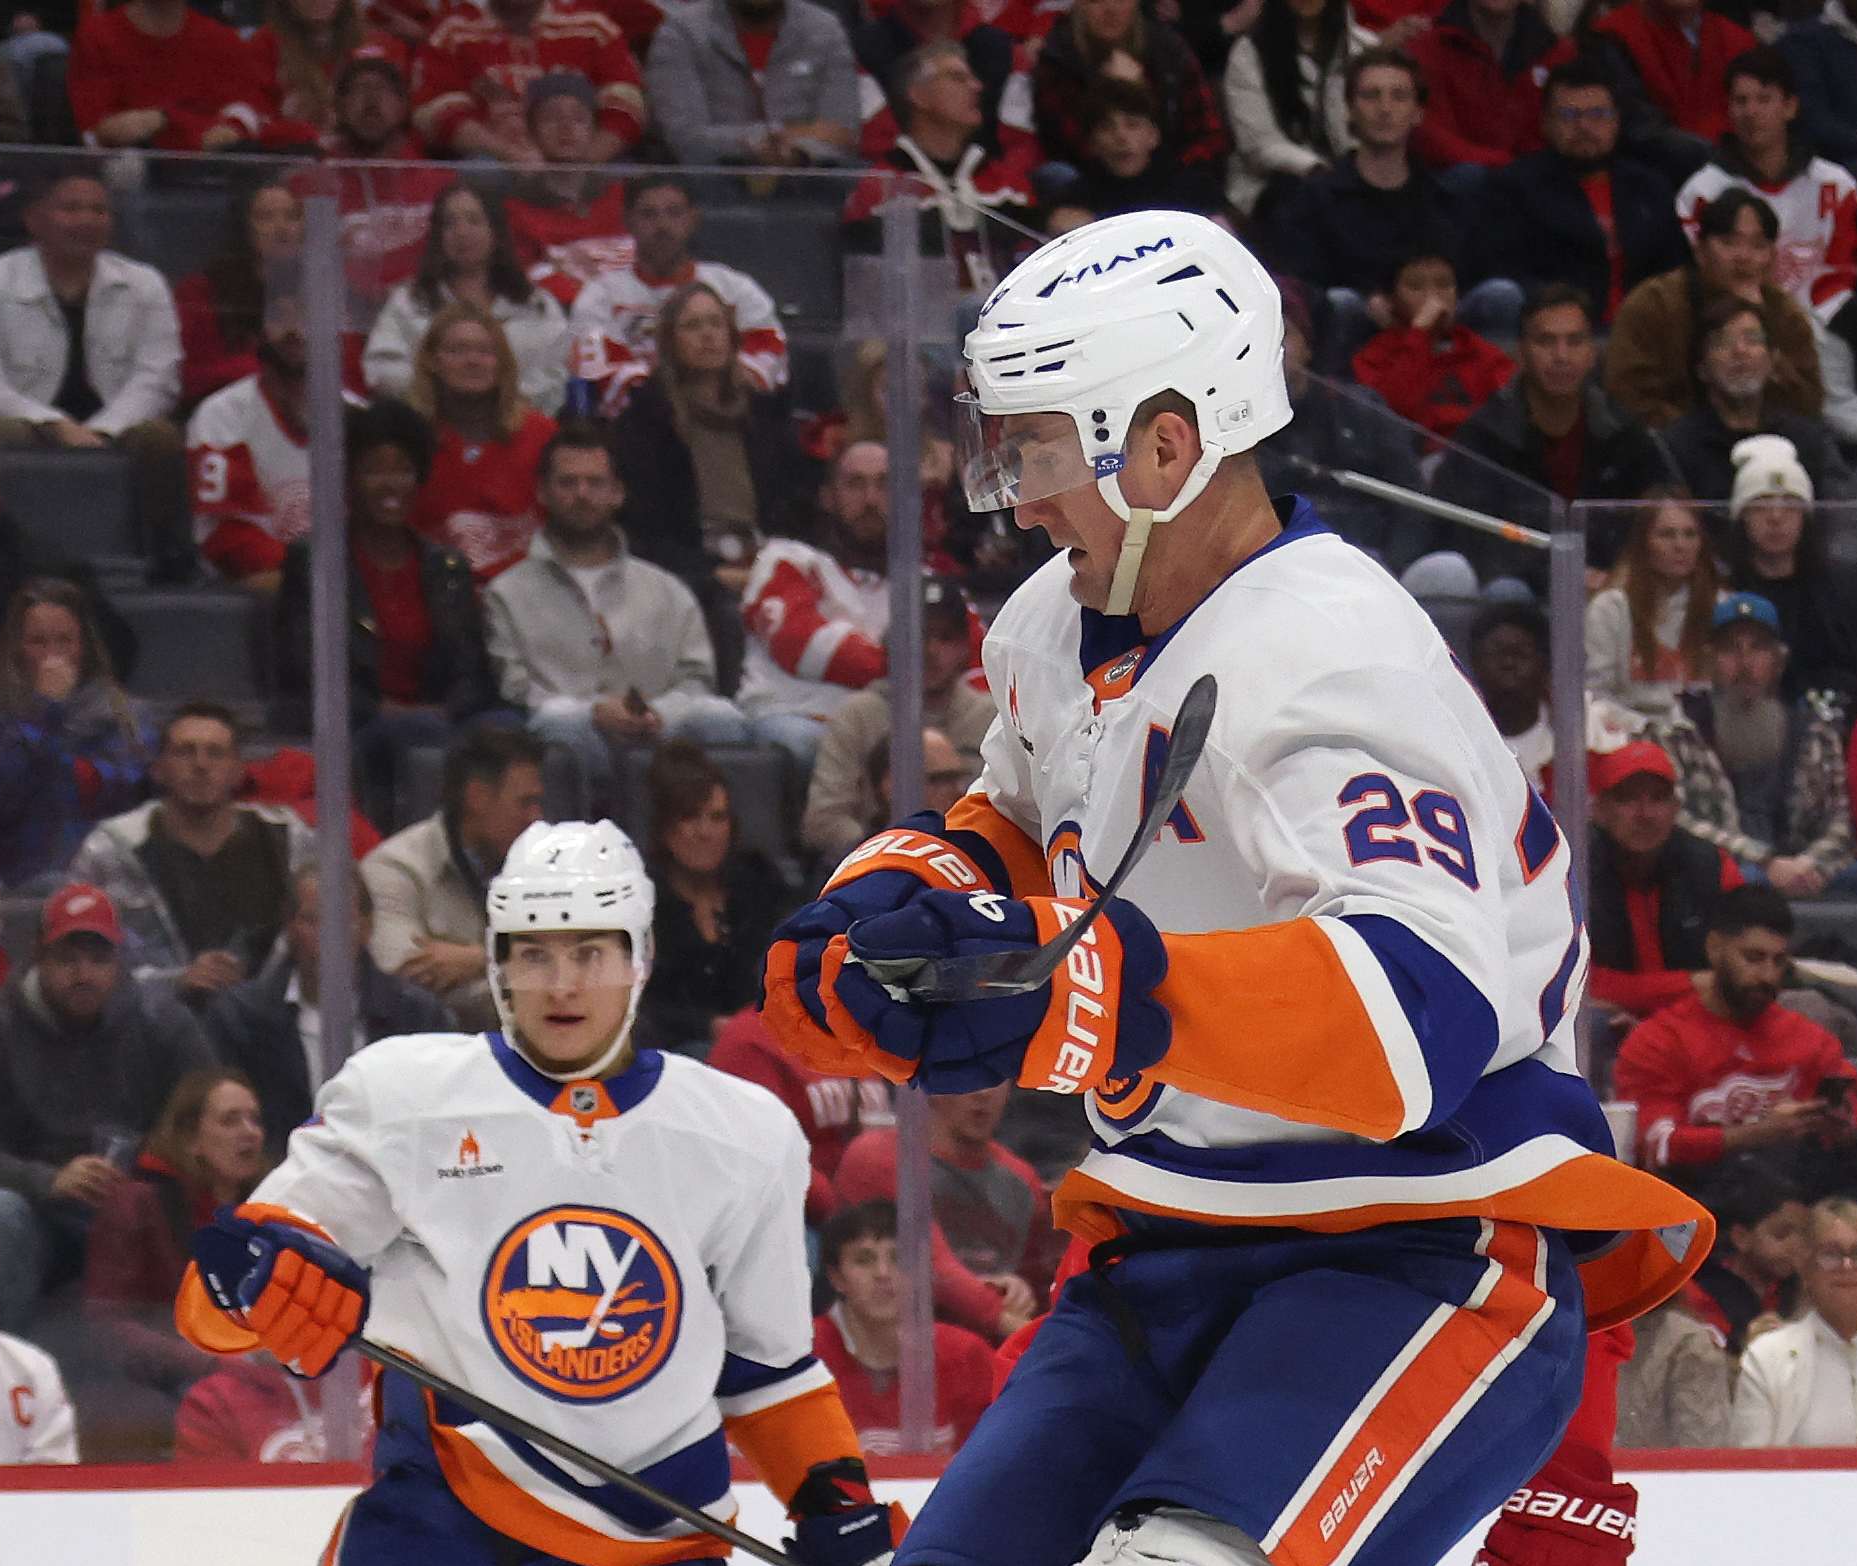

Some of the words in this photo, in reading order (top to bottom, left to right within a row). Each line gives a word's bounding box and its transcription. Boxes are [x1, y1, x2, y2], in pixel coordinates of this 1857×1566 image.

[818, 834, 978, 890] AUE
[1339, 772, 1482, 891] 29
[1319, 1446, 1385, 1543] BAUER
[1505, 1488, 1637, 1540] BAUER
